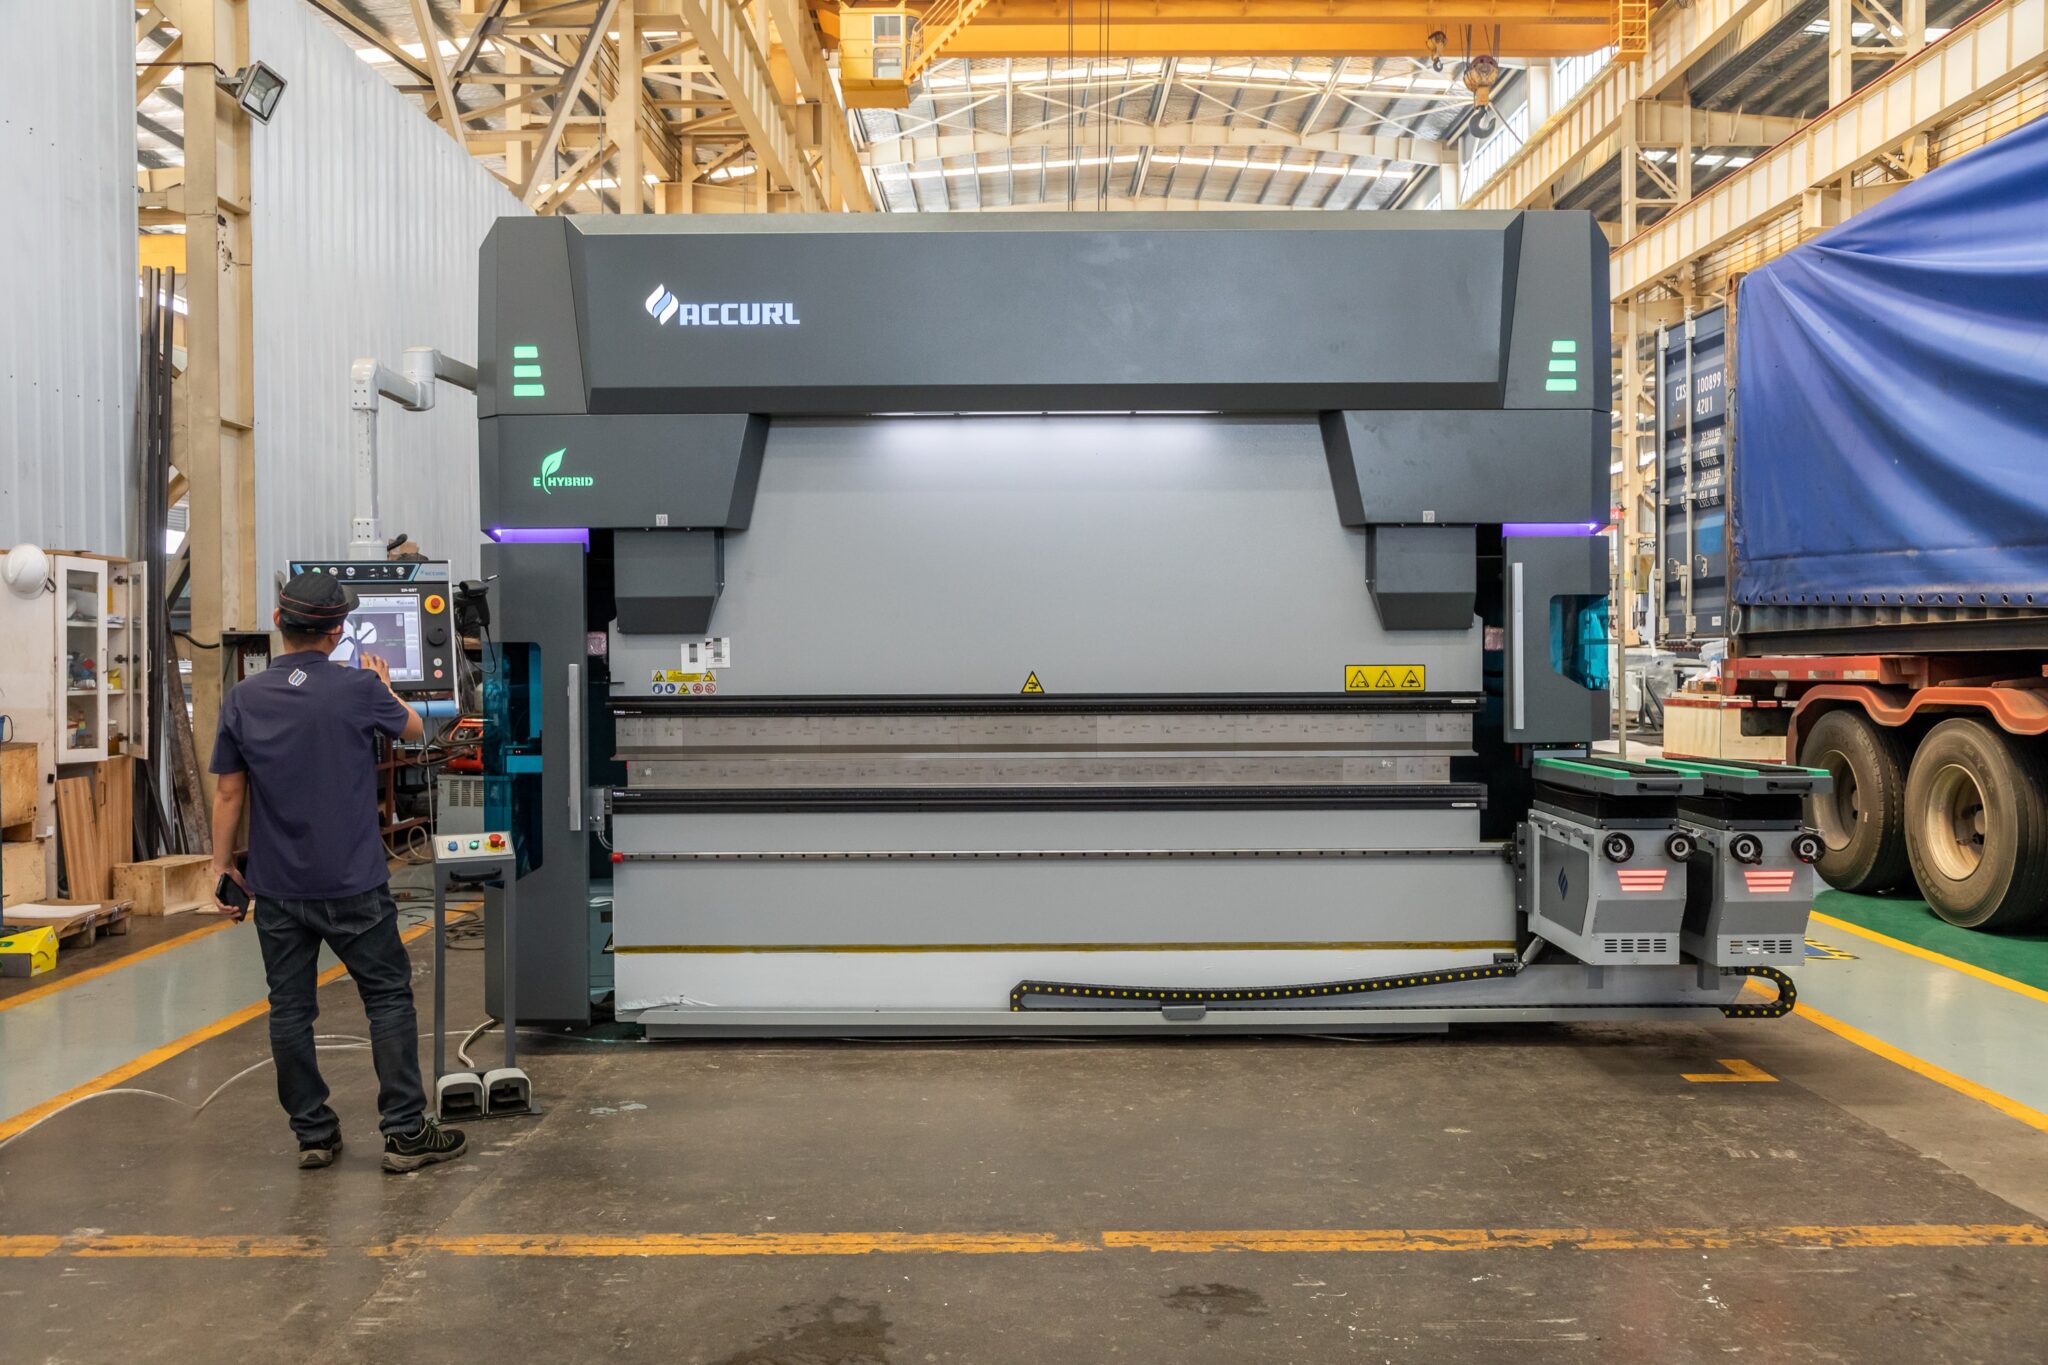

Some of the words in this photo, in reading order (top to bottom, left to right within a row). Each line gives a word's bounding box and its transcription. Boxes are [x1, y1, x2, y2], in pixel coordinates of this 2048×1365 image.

[679, 303, 800, 326] ACCURL
[1697, 371, 1721, 395] 100899
[1696, 396, 1712, 415] 42U1
[547, 477, 594, 487] HYBRID
